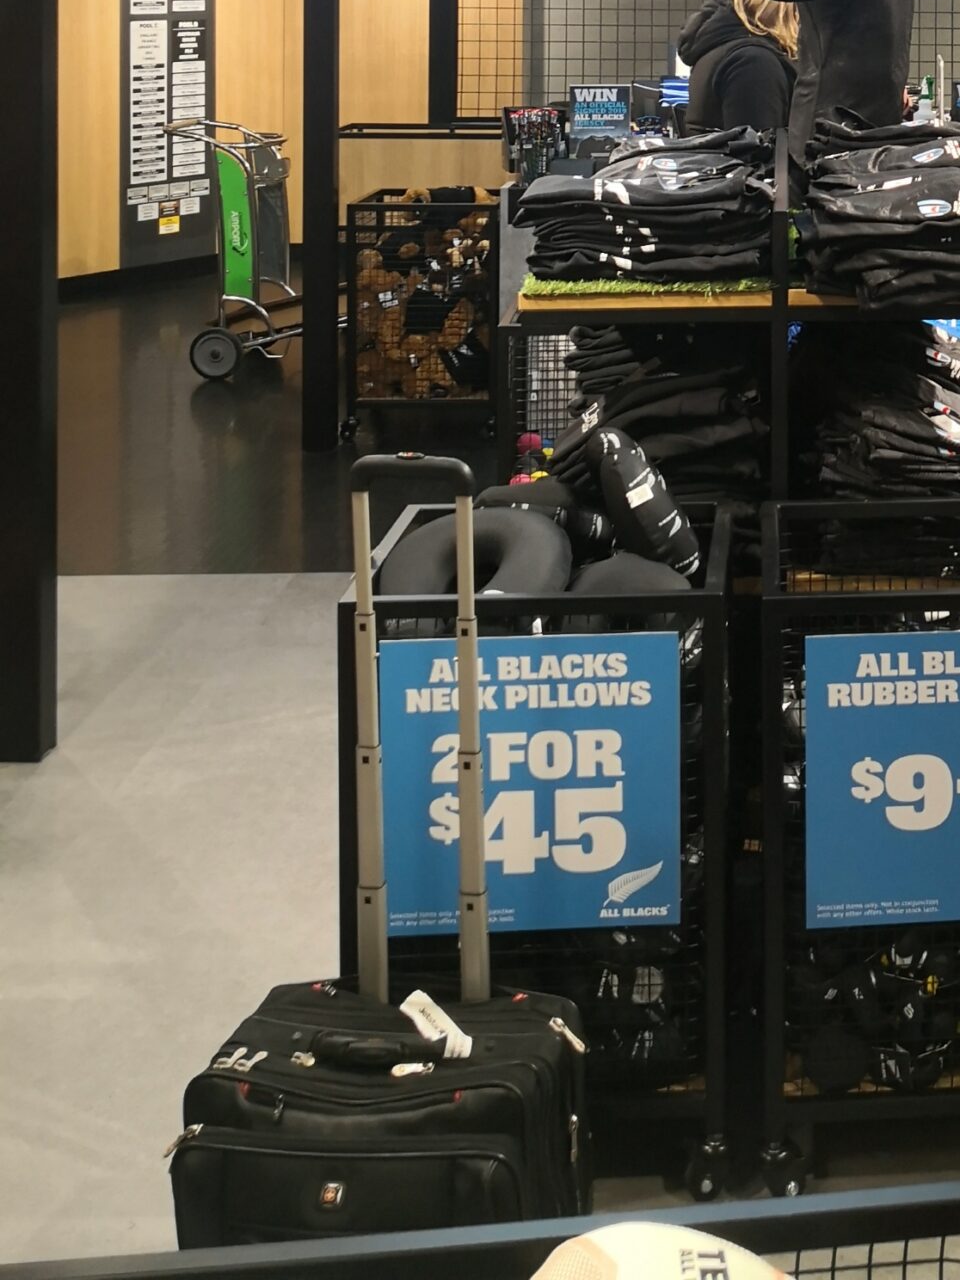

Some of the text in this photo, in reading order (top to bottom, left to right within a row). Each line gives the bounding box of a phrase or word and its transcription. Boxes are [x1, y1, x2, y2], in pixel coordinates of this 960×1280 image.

[574, 88, 617, 102] WIN
[231, 210, 241, 247] AIRPORT
[497, 652, 628, 682] BLACKS
[856, 653, 916, 678] ALL
[505, 681, 652, 710] PILLOWS
[827, 678, 960, 708] RUBBER
[487, 729, 625, 781] FOR
[429, 781, 627, 875] $45
[600, 906, 668, 918] ALL BLACKS
